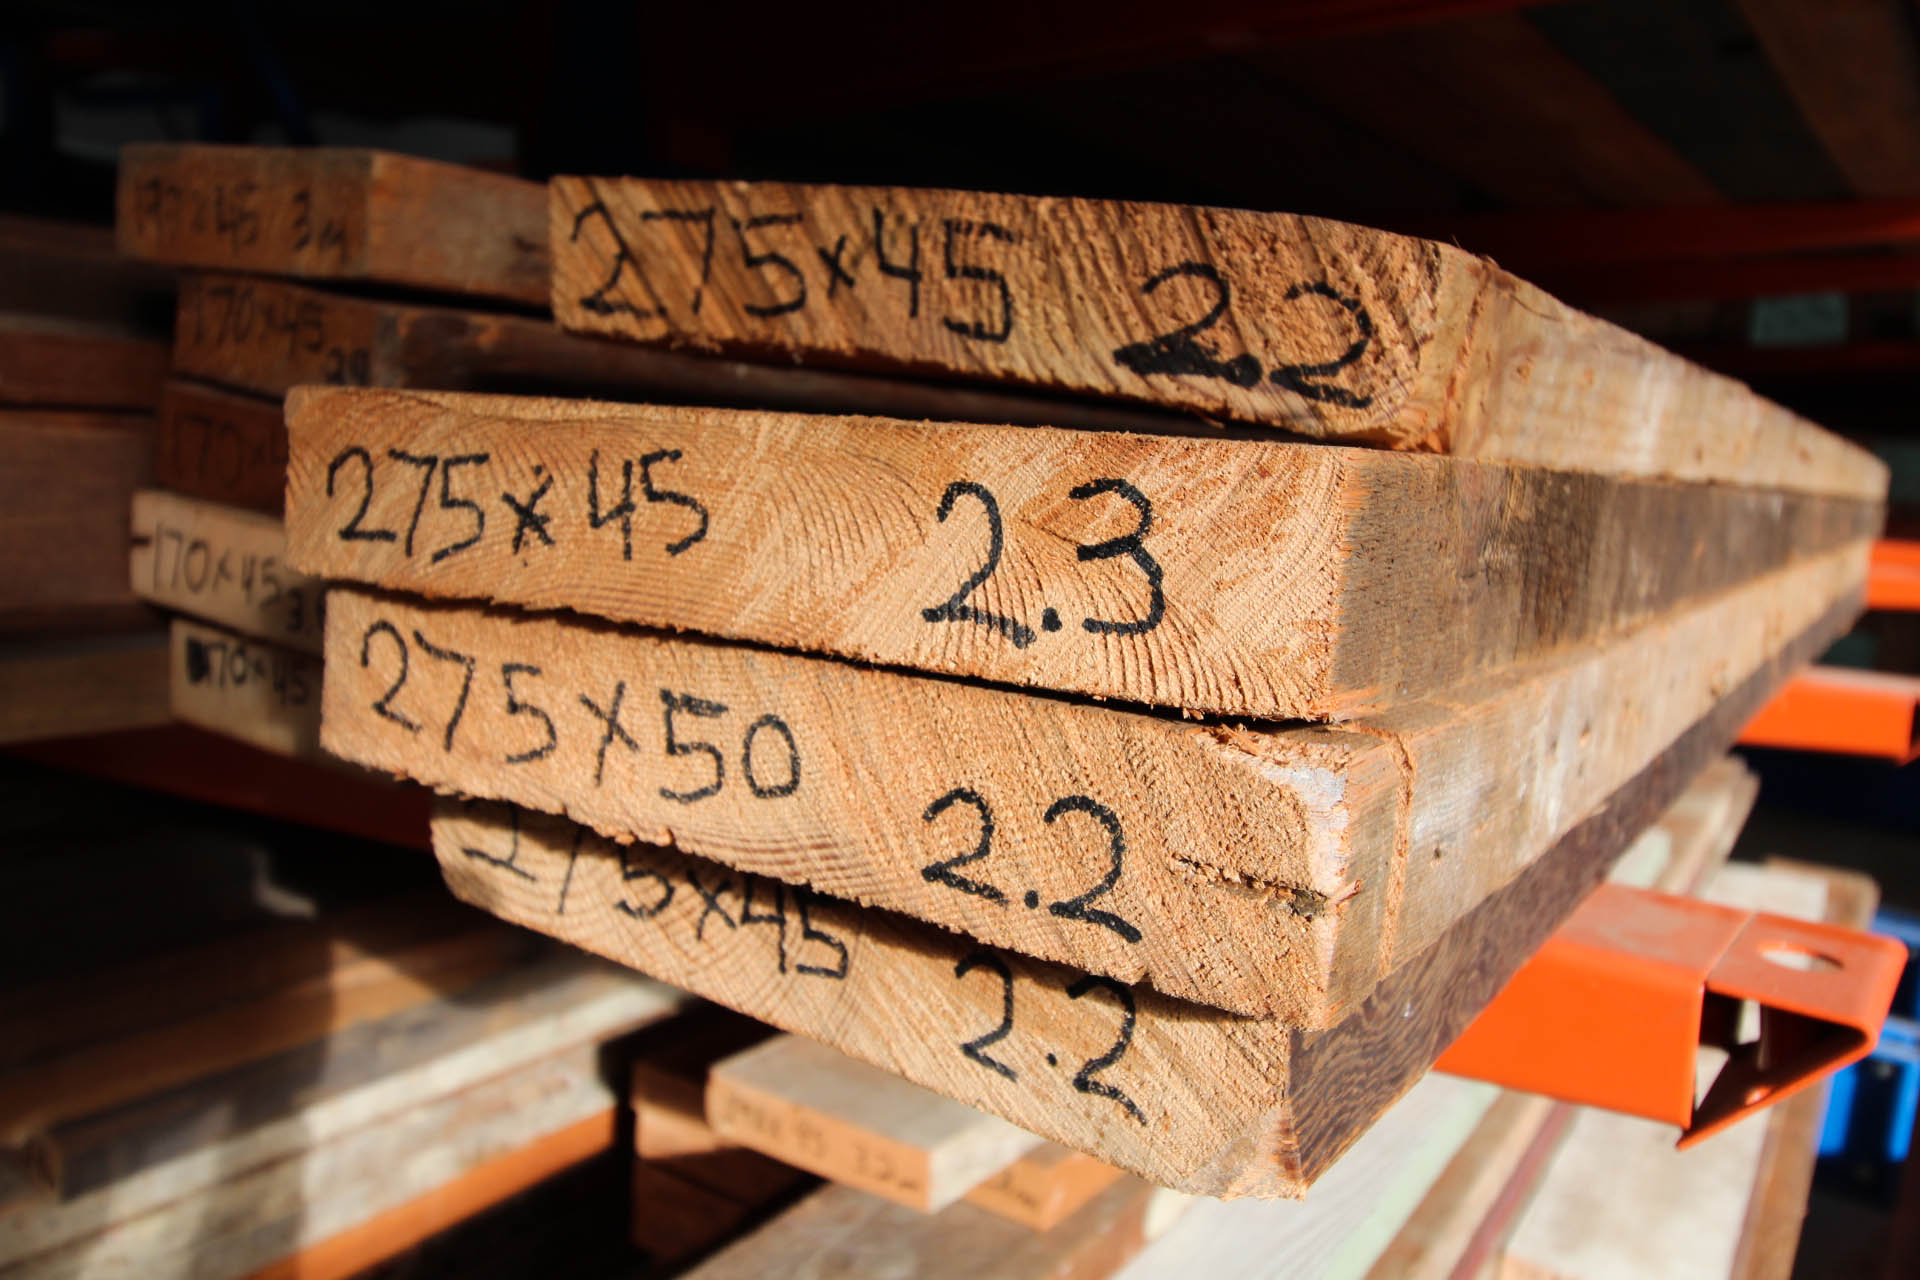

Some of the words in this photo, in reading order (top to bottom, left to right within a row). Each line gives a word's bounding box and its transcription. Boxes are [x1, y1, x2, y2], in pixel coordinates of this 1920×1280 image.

[572, 200, 1016, 341] 275x45
[152, 524, 282, 610] 170x45
[326, 445, 710, 564] 275x45
[922, 477, 1164, 648] 2.3
[360, 620, 800, 802] 275x50
[921, 787, 1142, 944] 2.2
[954, 951, 1148, 1126] 2.2
